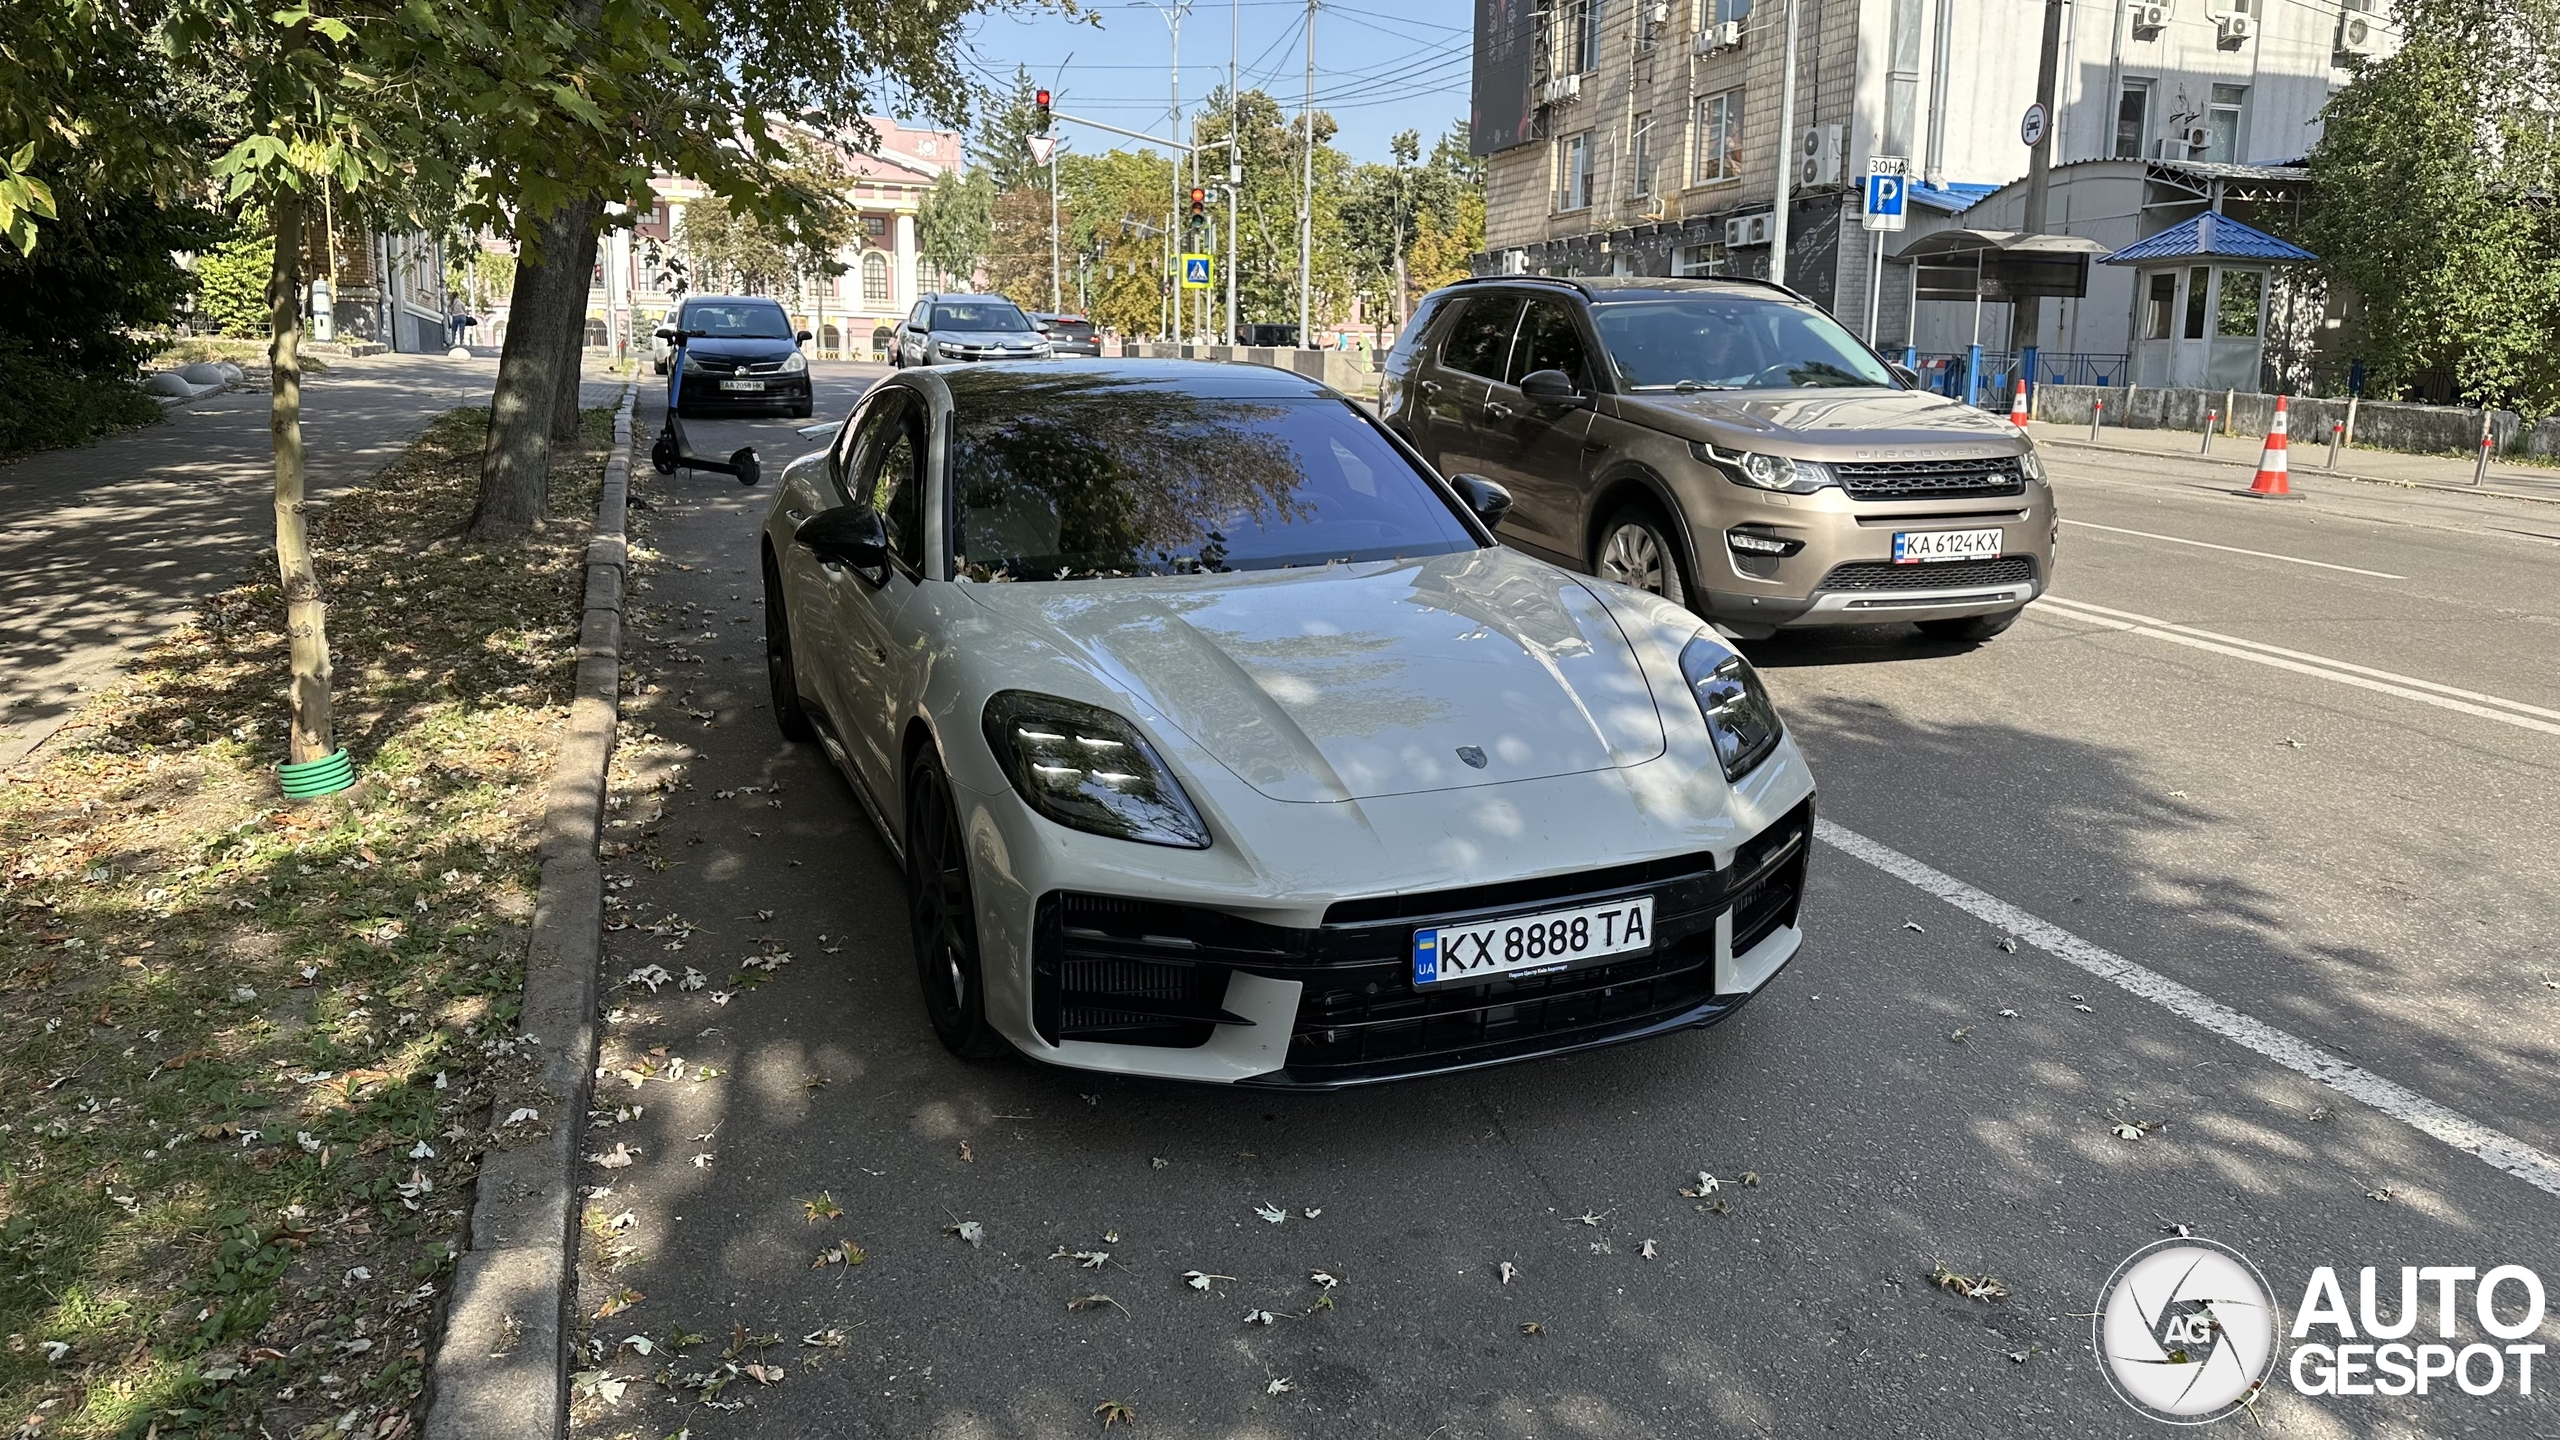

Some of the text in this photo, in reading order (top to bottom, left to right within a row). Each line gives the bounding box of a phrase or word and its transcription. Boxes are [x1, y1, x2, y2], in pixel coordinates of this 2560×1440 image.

[1870, 160, 1906, 174] ЗОНА
[1856, 448, 1995, 459] DISCOVERY
[1907, 532, 1999, 555] KA 6124 KX
[1441, 906, 1646, 973] KX 8888 TA
[1418, 963, 1435, 975] UA
